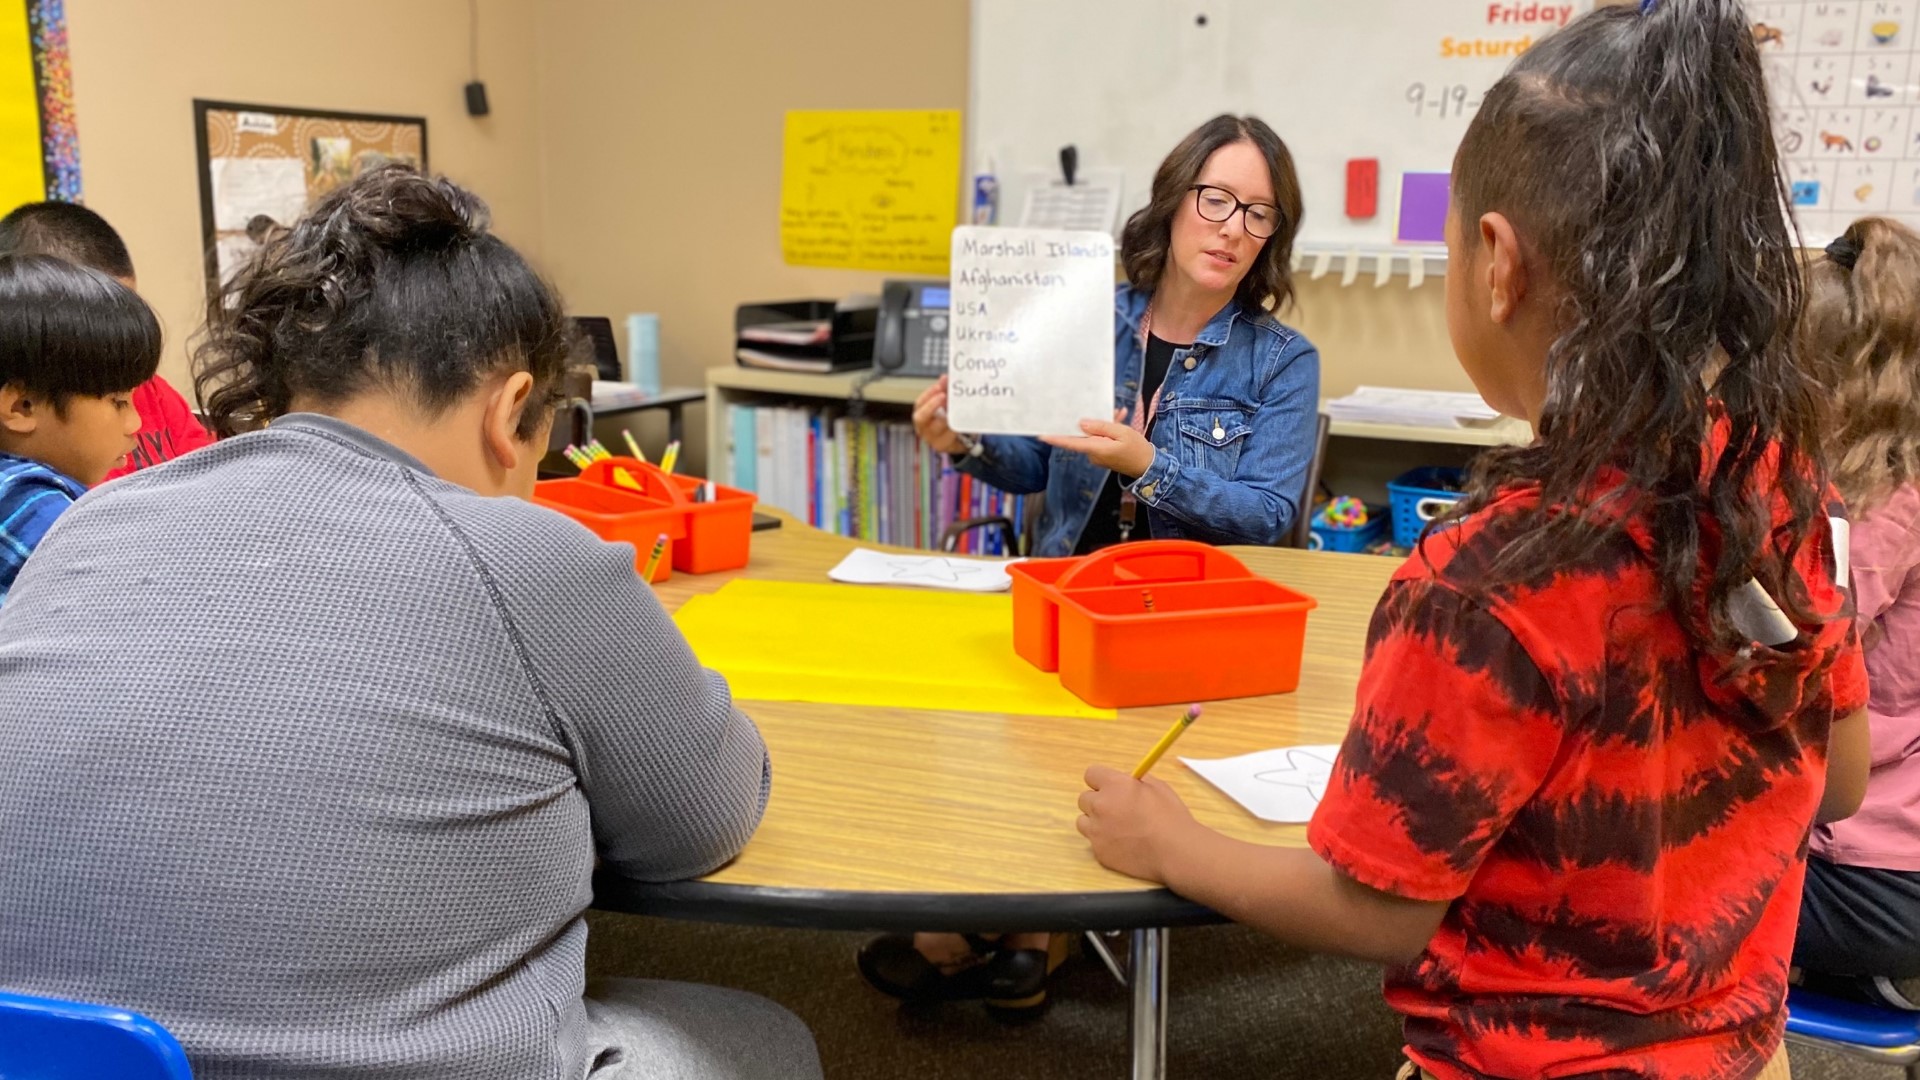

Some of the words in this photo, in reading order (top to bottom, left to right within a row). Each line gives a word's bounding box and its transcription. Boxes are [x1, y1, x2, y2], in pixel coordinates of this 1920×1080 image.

[1487, 3, 1573, 26] Friday
[1440, 35, 1532, 57] Saturd
[1405, 81, 1480, 119] 9-19-
[962, 238, 1036, 258] Marshall
[1046, 240, 1110, 258] Islands
[959, 267, 1066, 294] Afghanistan
[956, 302, 988, 316] USA
[955, 326, 1019, 343] Ukraine
[953, 351, 1007, 378] Congo
[952, 380, 1015, 397] Sudan
